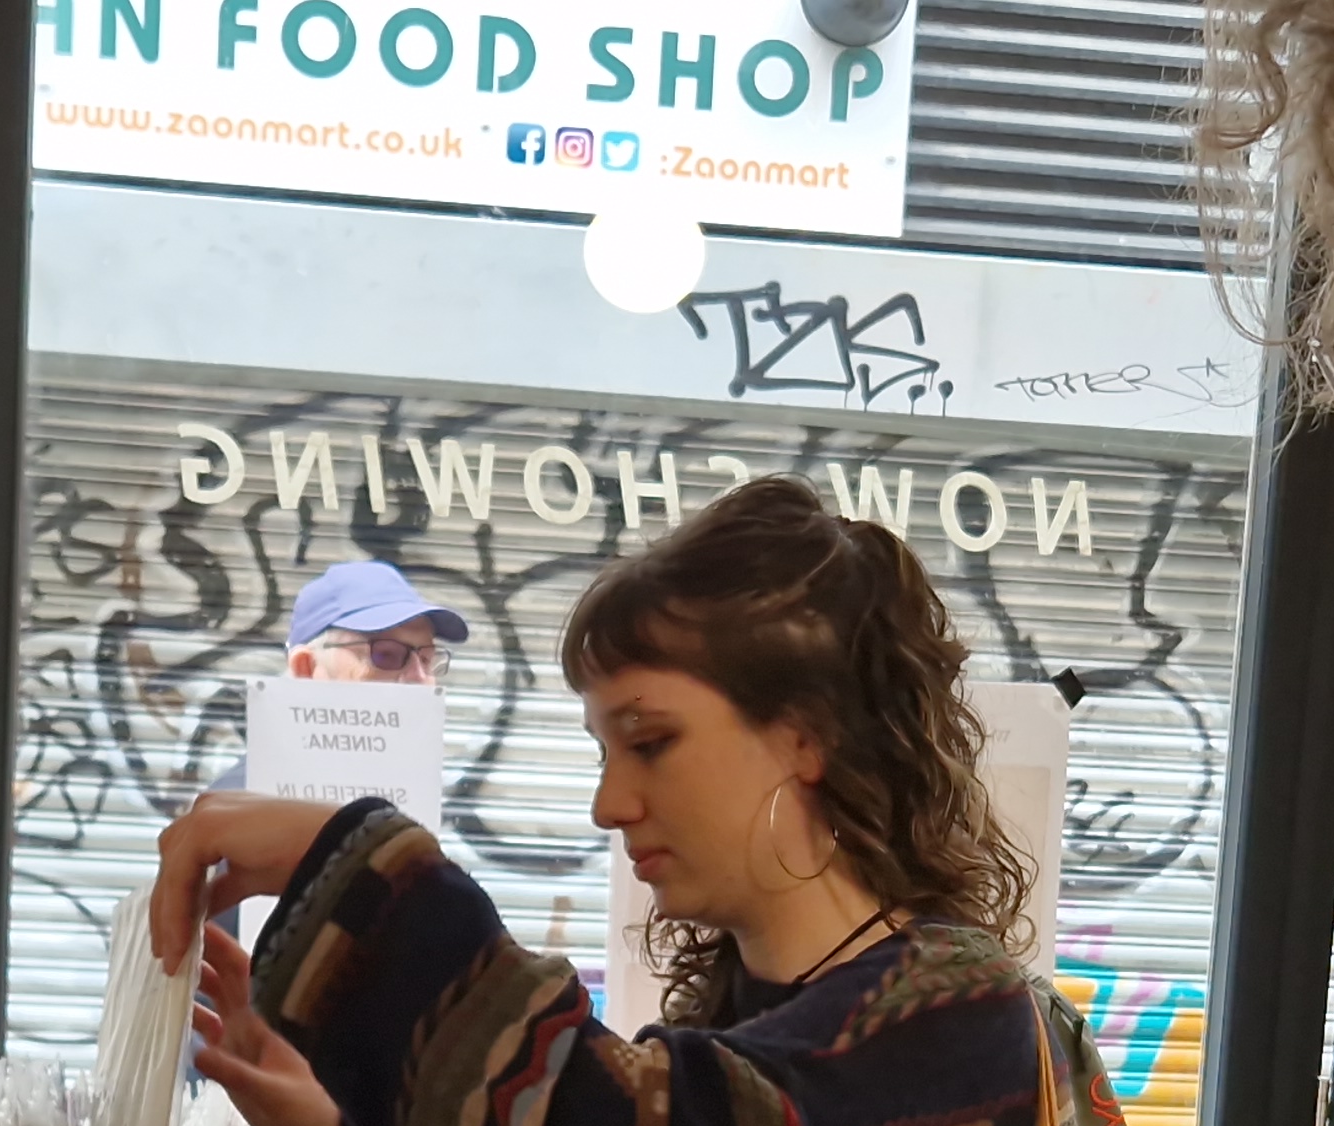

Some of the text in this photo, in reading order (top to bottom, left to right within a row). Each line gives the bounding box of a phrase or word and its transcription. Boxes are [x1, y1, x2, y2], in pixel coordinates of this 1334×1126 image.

[217, 0, 536, 93] FOOD
[586, 26, 884, 122] SHOP
[46, 101, 464, 158] www.zaonmart.co.uk
